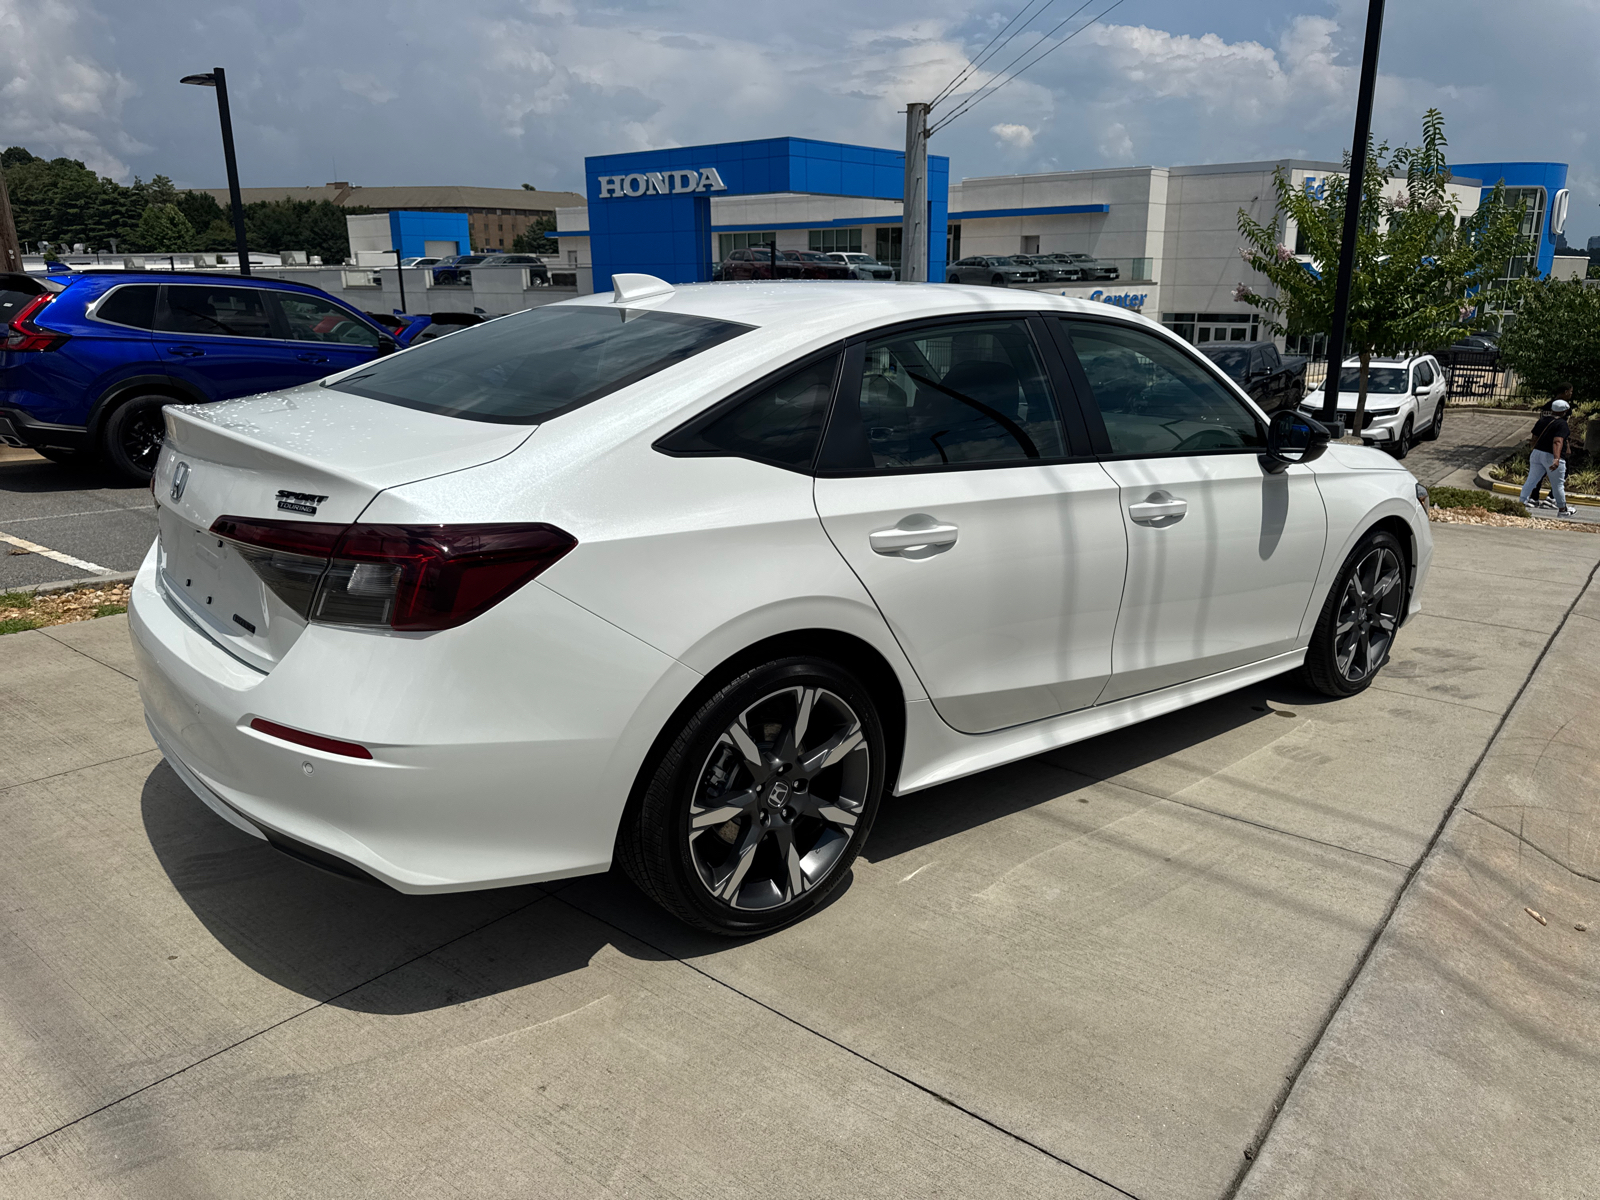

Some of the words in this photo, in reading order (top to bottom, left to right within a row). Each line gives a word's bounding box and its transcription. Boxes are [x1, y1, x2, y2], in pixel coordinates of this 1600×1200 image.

[598, 167, 727, 199] HONDA
[275, 489, 330, 503] SPORT
[279, 502, 314, 513] TOURING
